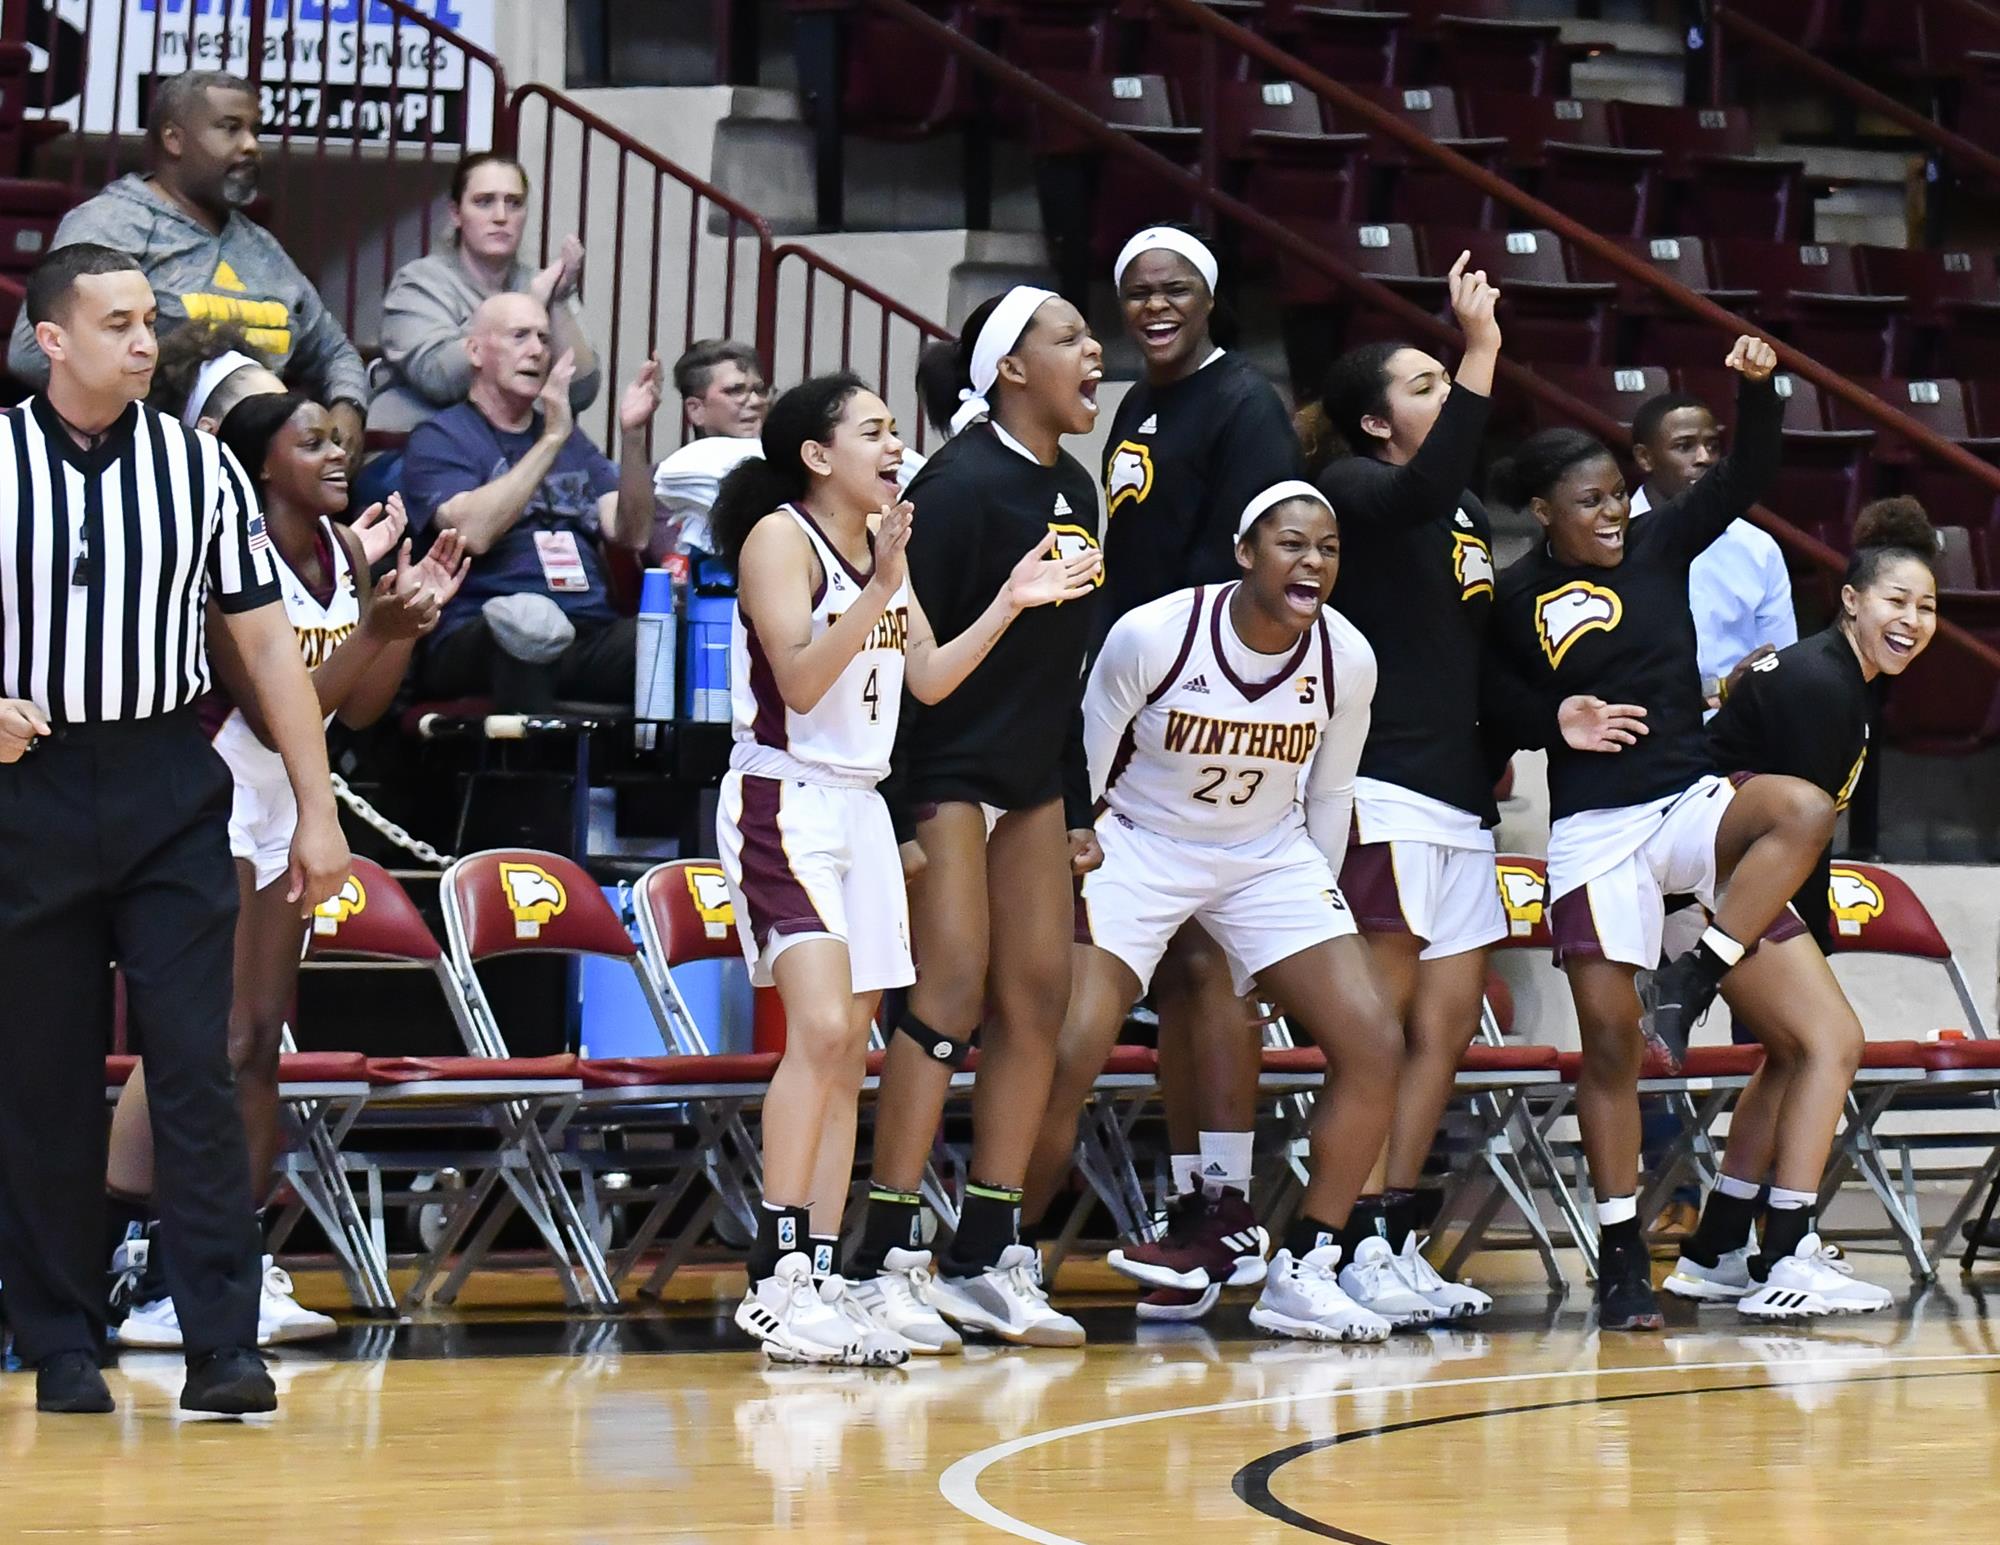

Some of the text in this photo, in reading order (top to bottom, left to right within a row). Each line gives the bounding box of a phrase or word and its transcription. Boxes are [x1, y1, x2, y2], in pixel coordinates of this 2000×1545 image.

[862, 666, 880, 723] 4
[1164, 708, 1318, 767] WINTHROP
[1191, 765, 1266, 807] 23
